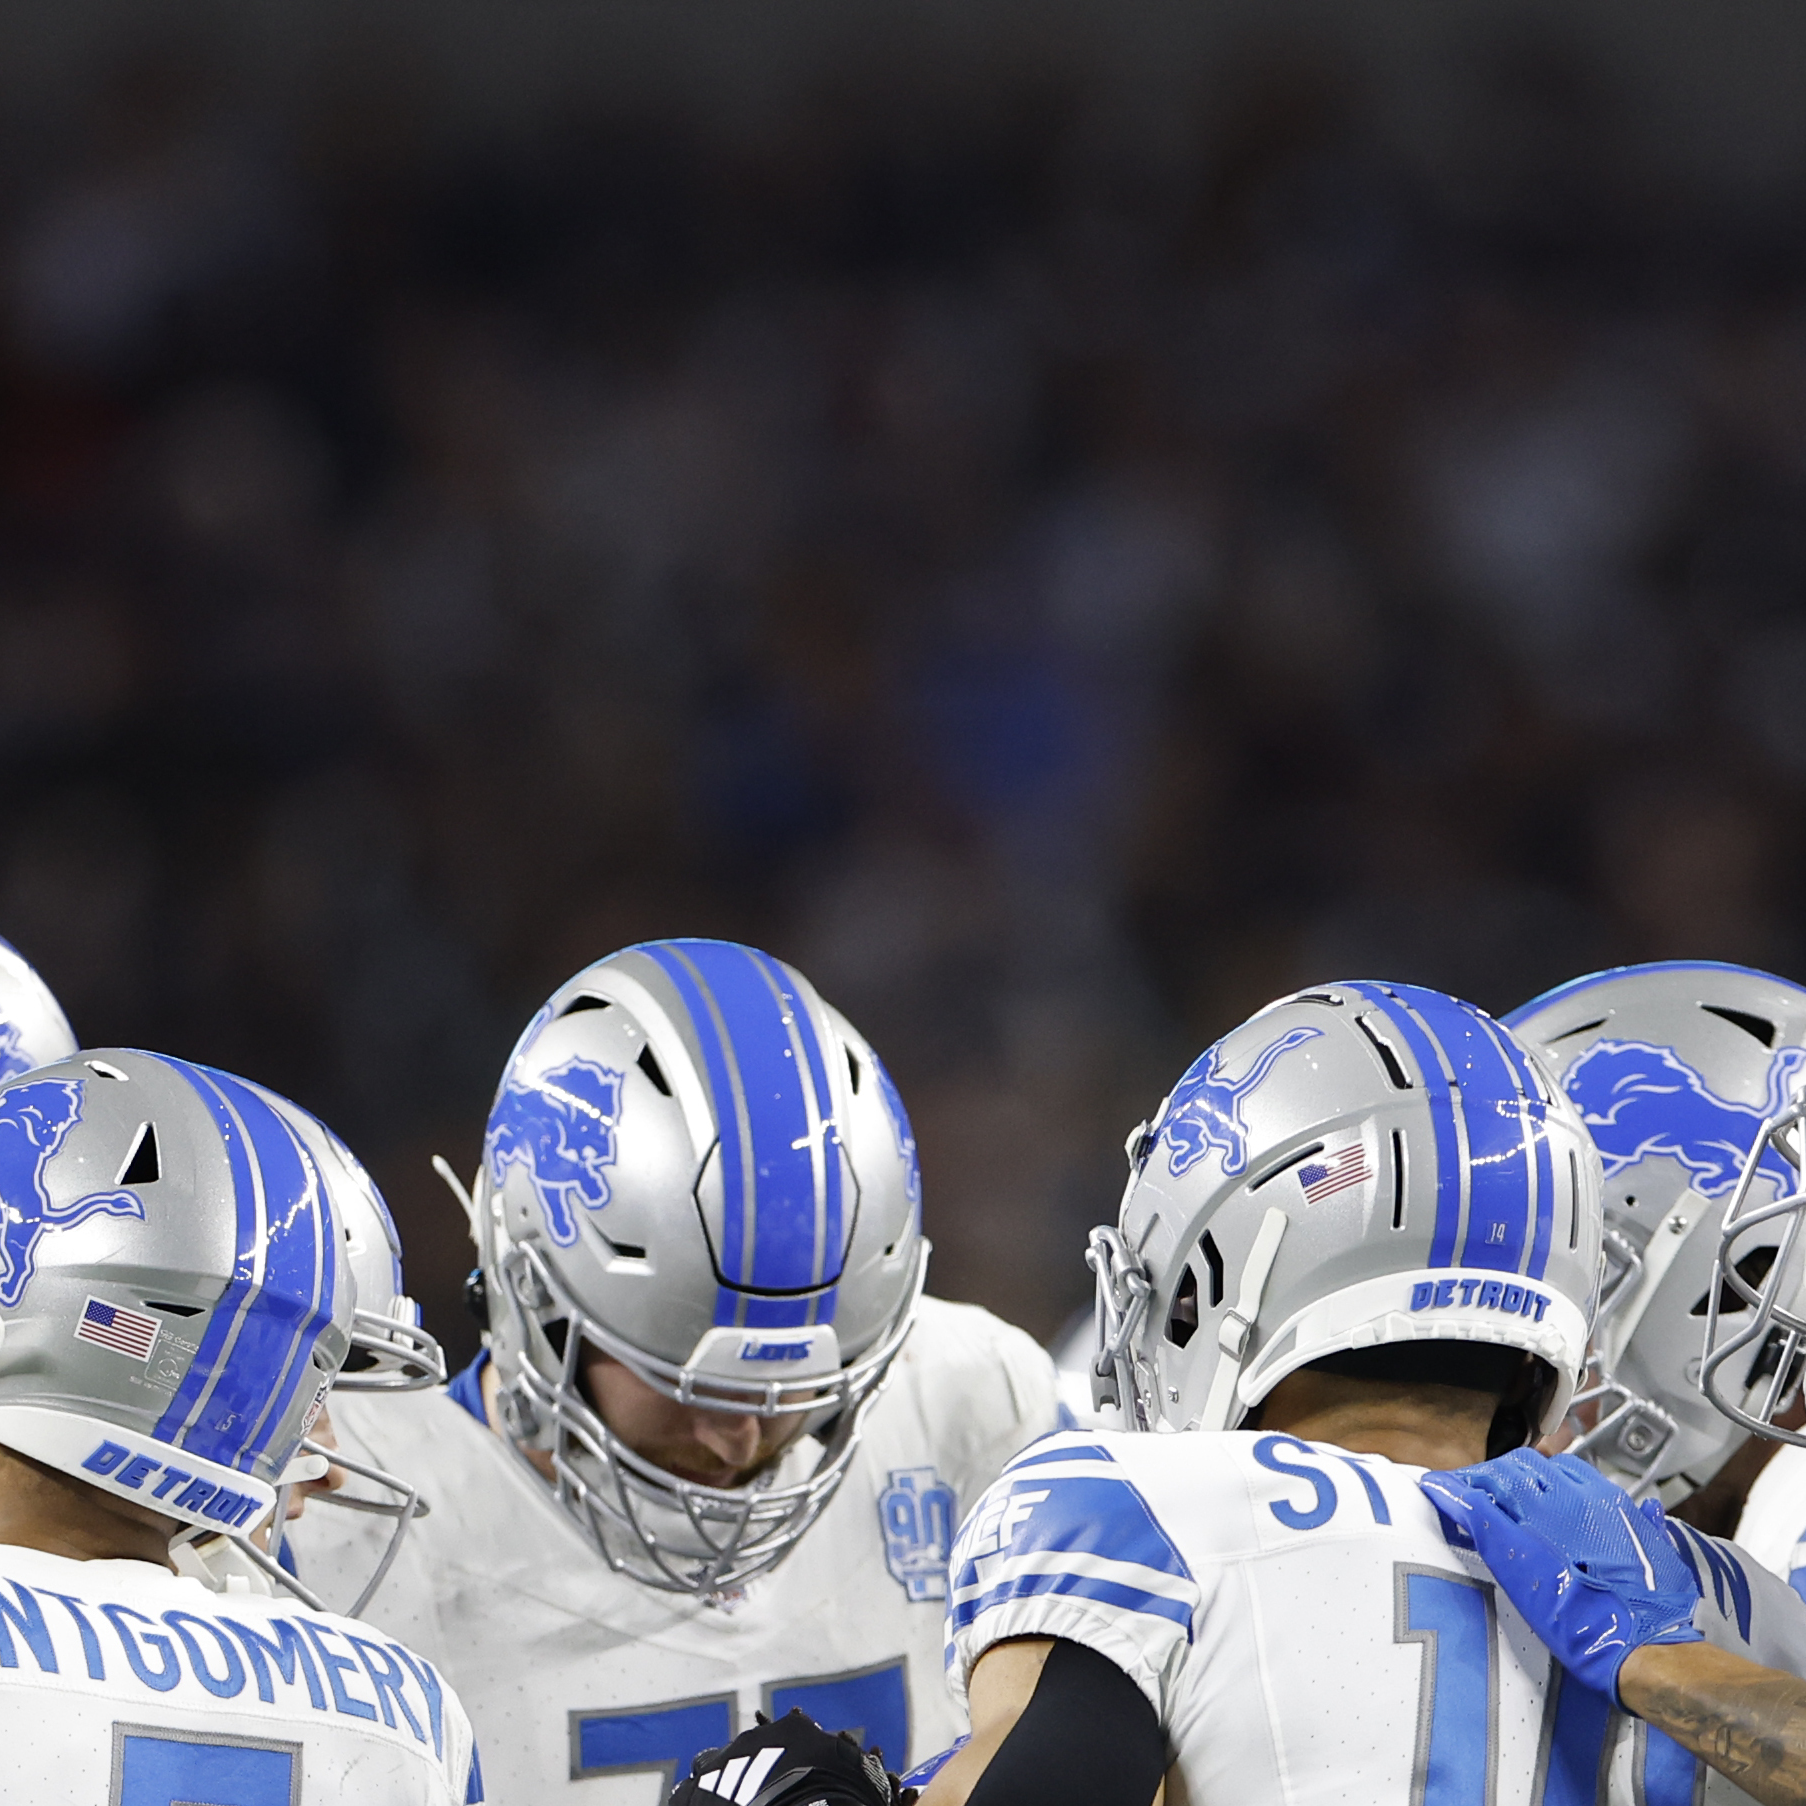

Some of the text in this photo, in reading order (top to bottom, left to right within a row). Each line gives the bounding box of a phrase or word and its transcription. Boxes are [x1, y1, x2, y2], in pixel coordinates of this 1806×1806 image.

[1491, 1222, 1506, 1243] 14
[1409, 1278, 1553, 1323] DETROIT
[80, 1439, 264, 1529] DETROIT
[886, 1487, 956, 1558] 90
